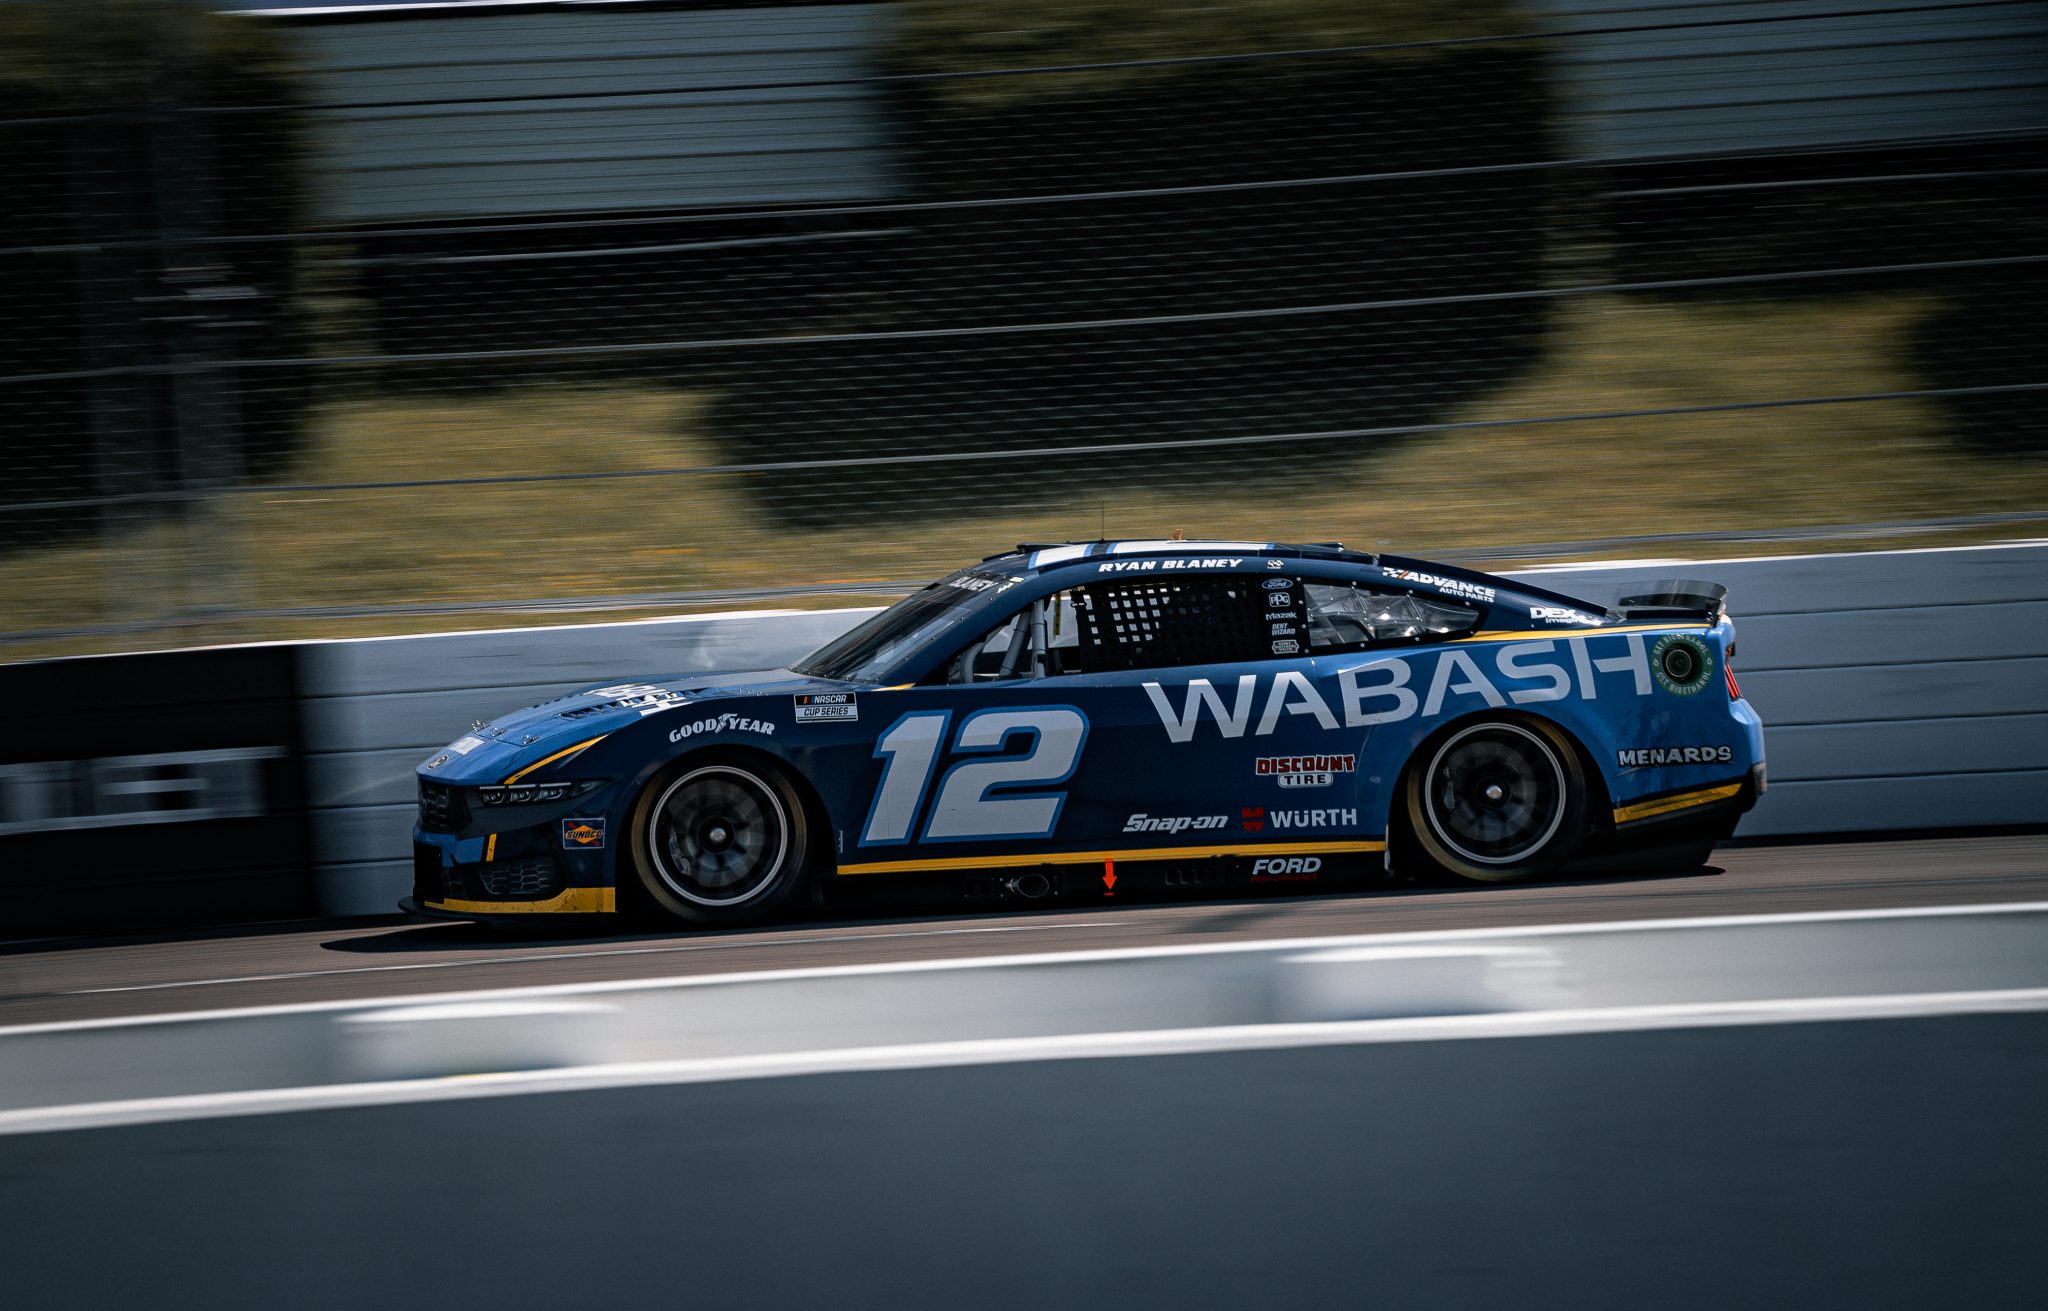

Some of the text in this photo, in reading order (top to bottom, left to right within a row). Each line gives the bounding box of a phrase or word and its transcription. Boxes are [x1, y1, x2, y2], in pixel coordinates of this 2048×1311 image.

[1099, 559, 1243, 572] RYAN BLANEY
[1405, 571, 1496, 597] ADVANCE
[1270, 594, 1289, 606] PPG
[1439, 587, 1494, 603] AUTO PARTS
[1265, 612, 1297, 620] Mazak
[1530, 607, 1577, 619] DEX
[1271, 628, 1296, 636] WIZARD
[1142, 633, 1653, 743] WABASH
[814, 694, 847, 704] NASCAR
[804, 706, 848, 717] CUP SERIES
[1618, 746, 1732, 766] MENARDS
[1255, 754, 1355, 775] DISCOUNT
[857, 703, 1090, 848] 12
[1284, 774, 1326, 785] TIRE
[1122, 813, 1228, 834] Snap-on
[565, 830, 604, 840] SUNOCO
[1252, 857, 1322, 875] FORD
